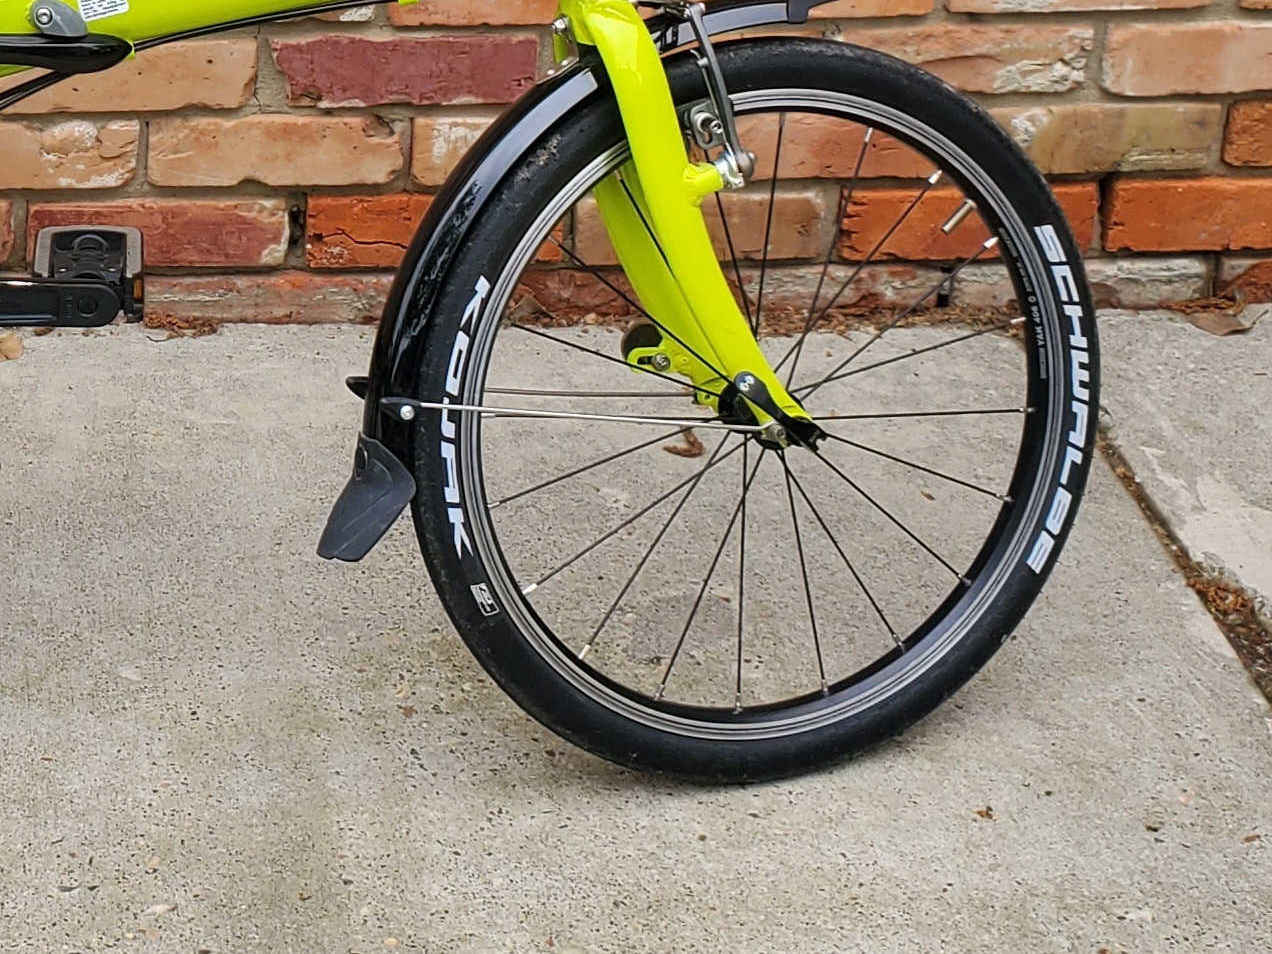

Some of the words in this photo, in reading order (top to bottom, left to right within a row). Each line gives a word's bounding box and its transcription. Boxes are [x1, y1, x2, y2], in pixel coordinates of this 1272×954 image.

[1031, 305, 1041, 324] 406
[1035, 324, 1046, 346] YAK
[440, 274, 491, 561] KOJAK
[1028, 224, 1091, 576] SCHWALBE
